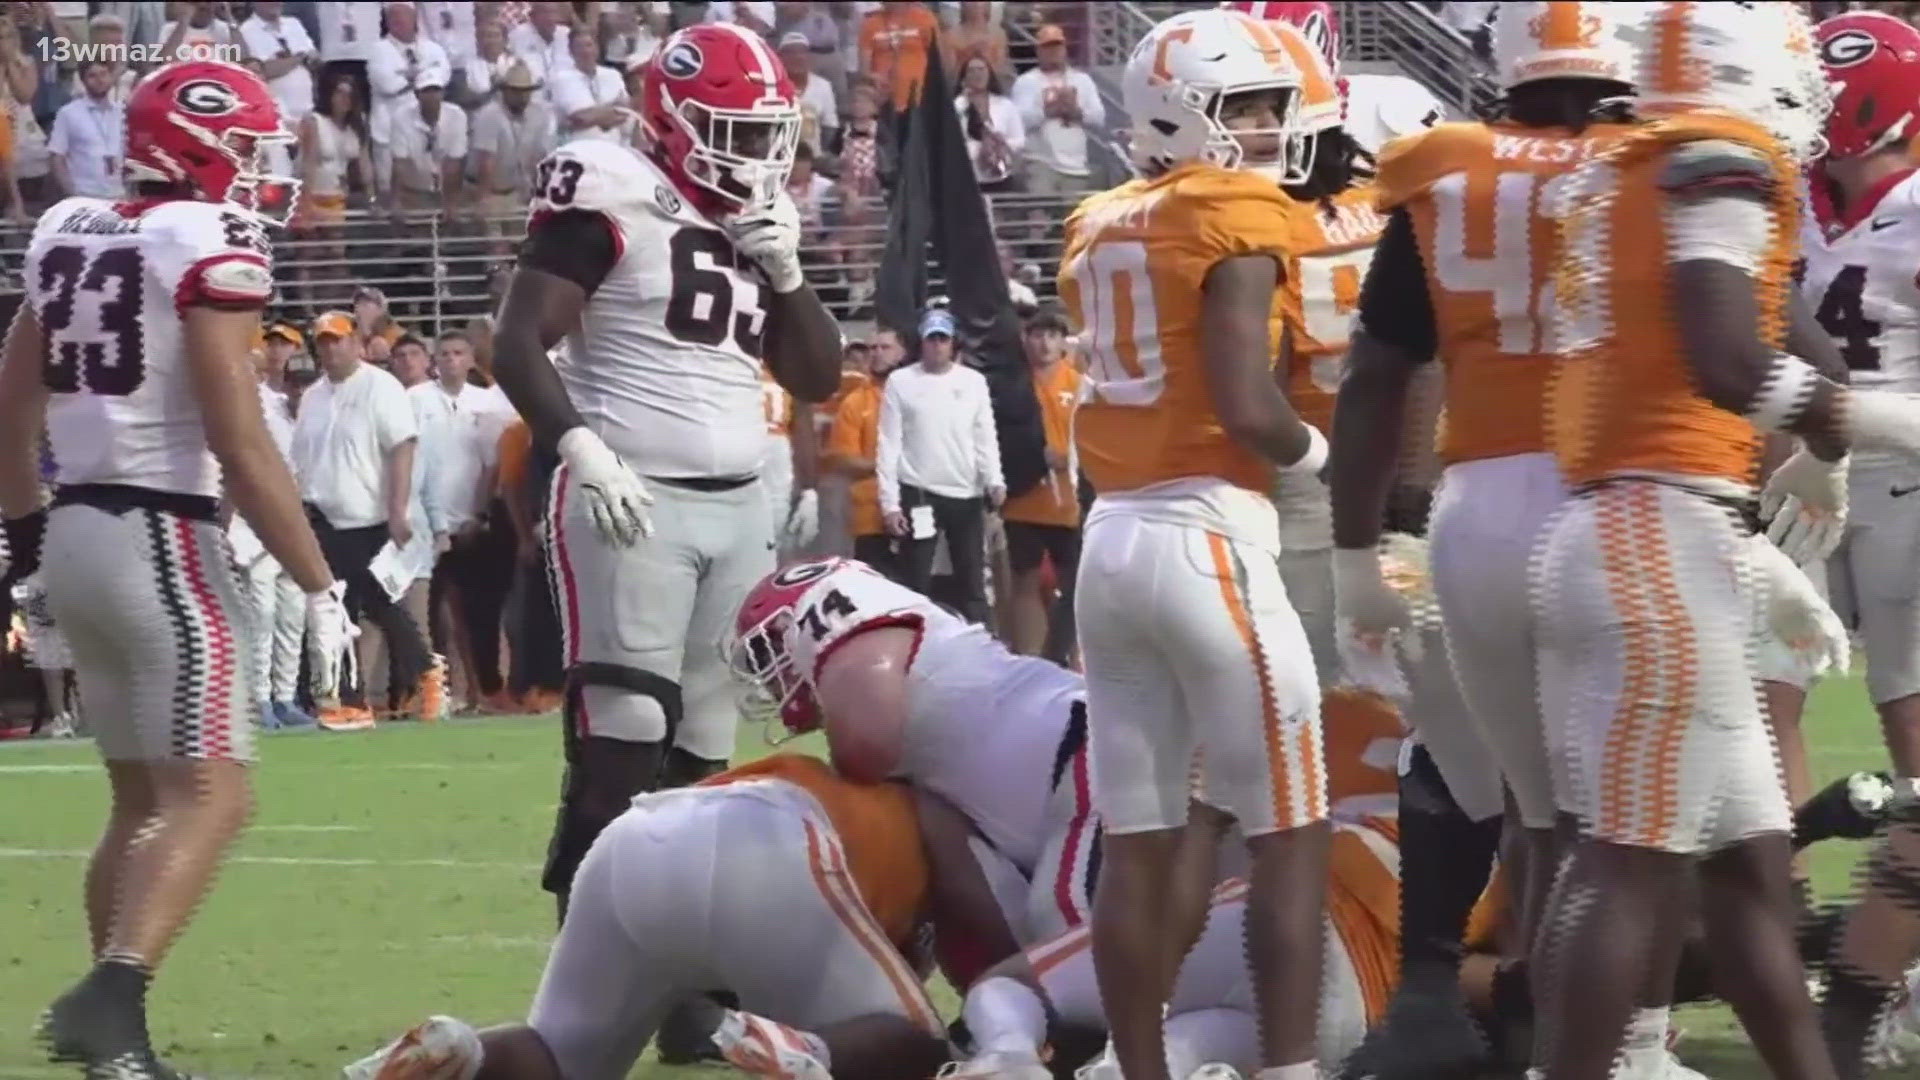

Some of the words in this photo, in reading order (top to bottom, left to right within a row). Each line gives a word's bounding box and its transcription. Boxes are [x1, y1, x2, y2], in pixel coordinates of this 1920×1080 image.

[174, 79, 239, 117] G
[39, 245, 145, 396] 23
[797, 588, 857, 642] 74
